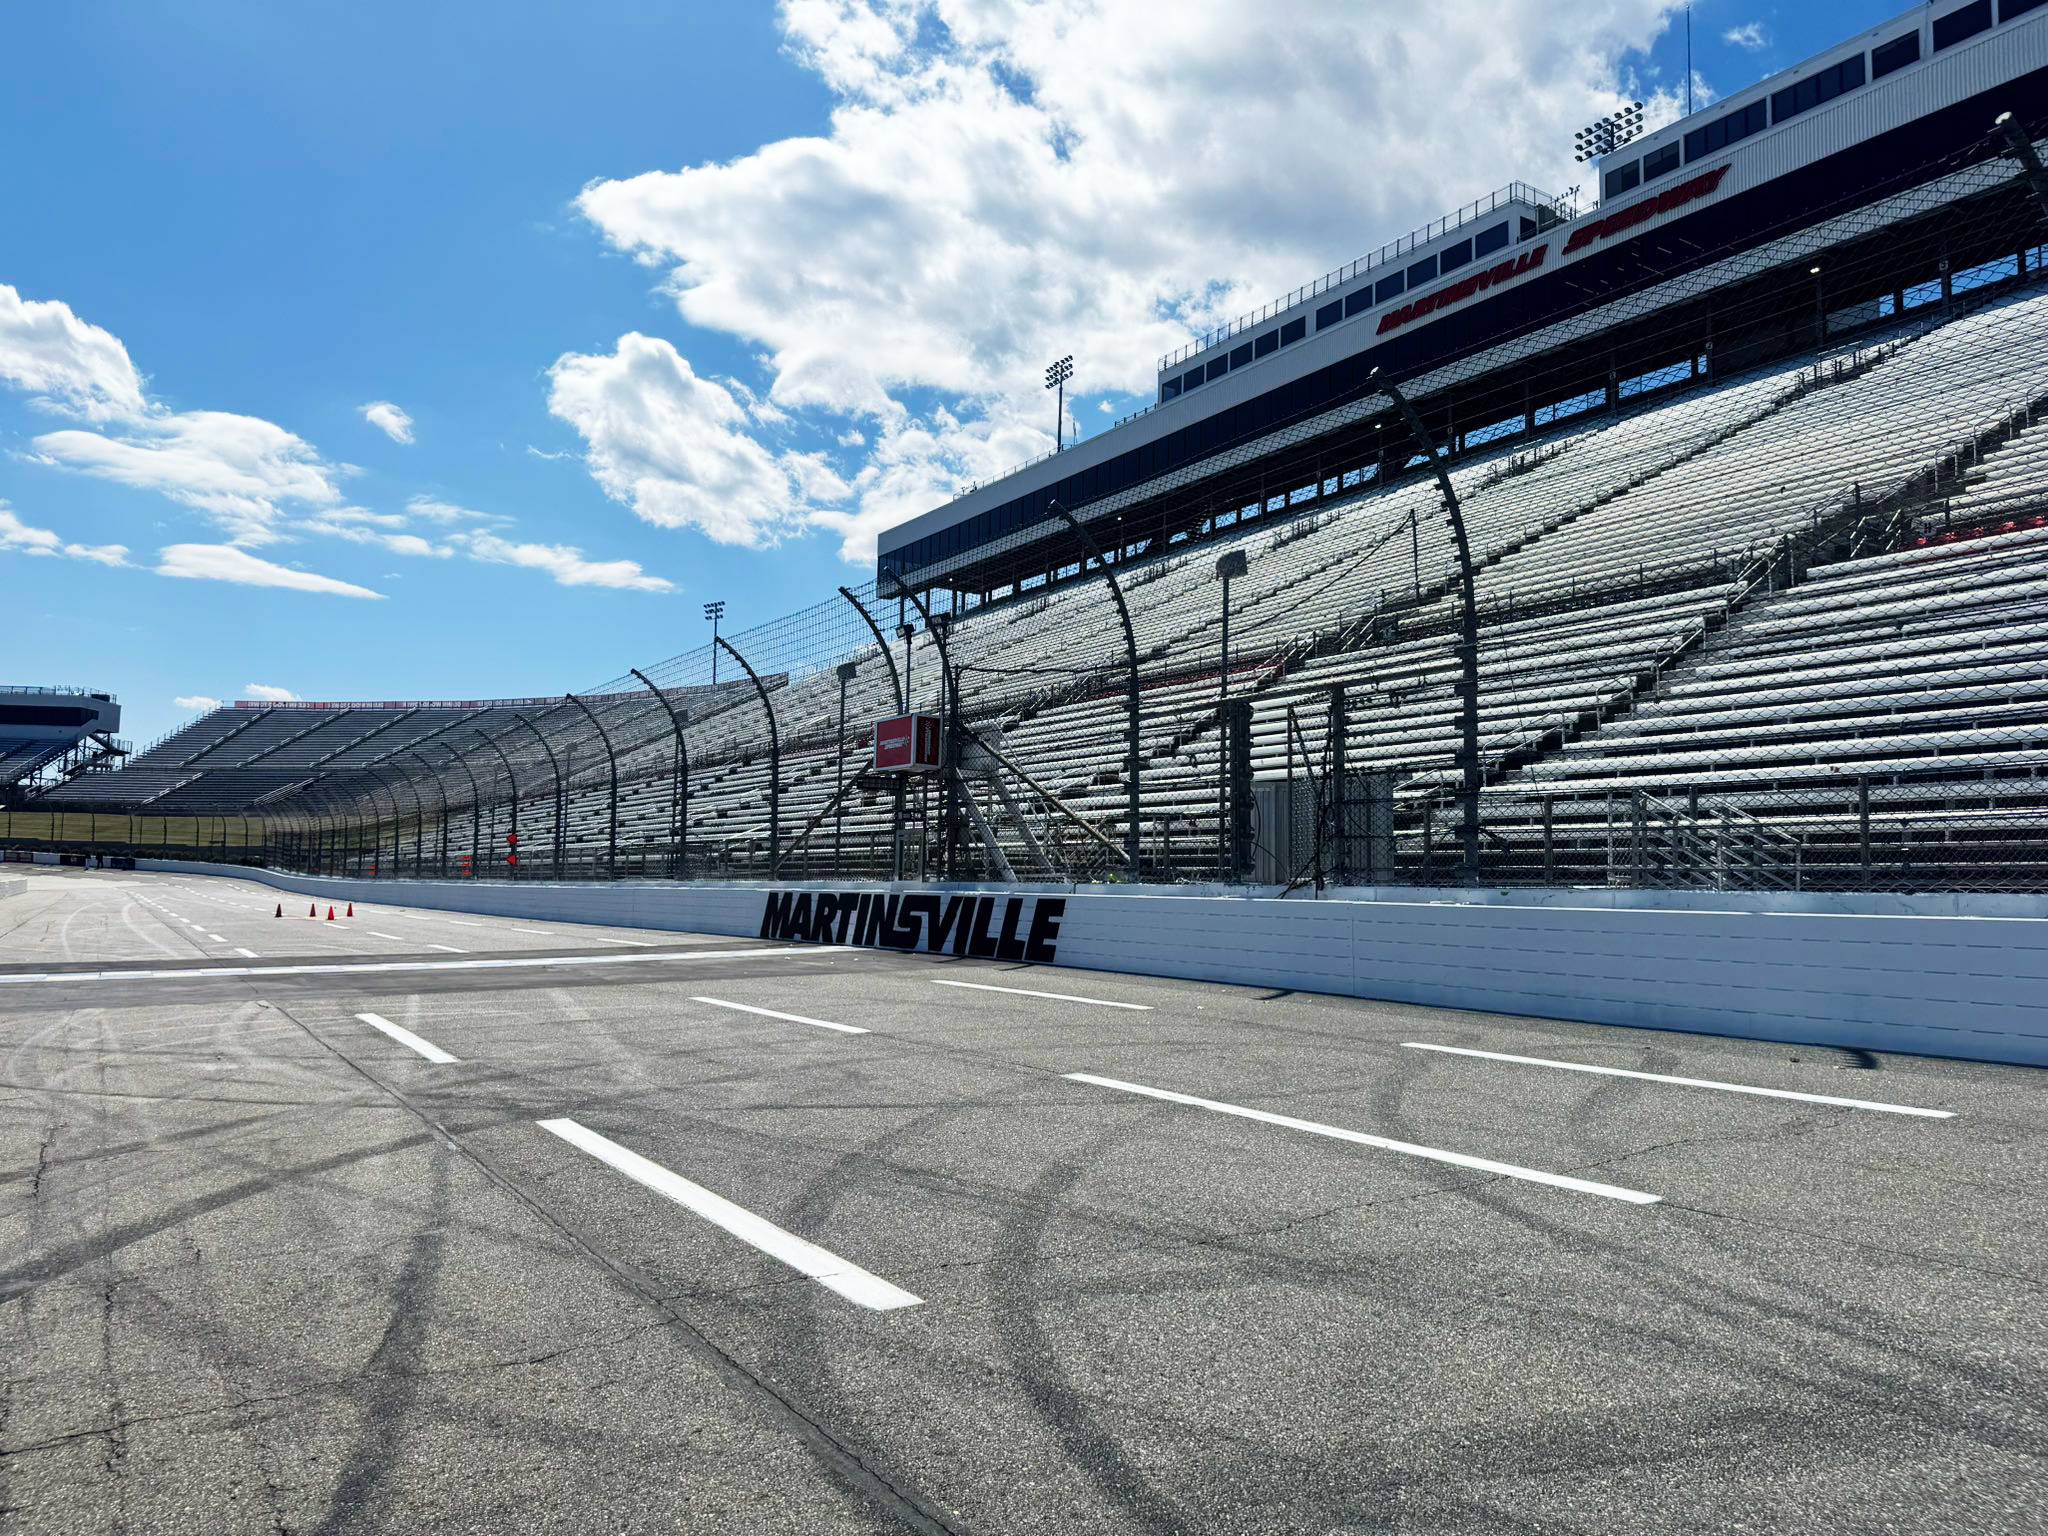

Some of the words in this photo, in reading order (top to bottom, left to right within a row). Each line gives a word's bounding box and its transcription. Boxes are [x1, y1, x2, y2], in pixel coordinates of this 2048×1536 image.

[1376, 244, 1548, 335] MARTINSVILLE
[1562, 163, 1732, 255] SPEEDWAY
[760, 891, 1066, 962] MARTINSVILLE
